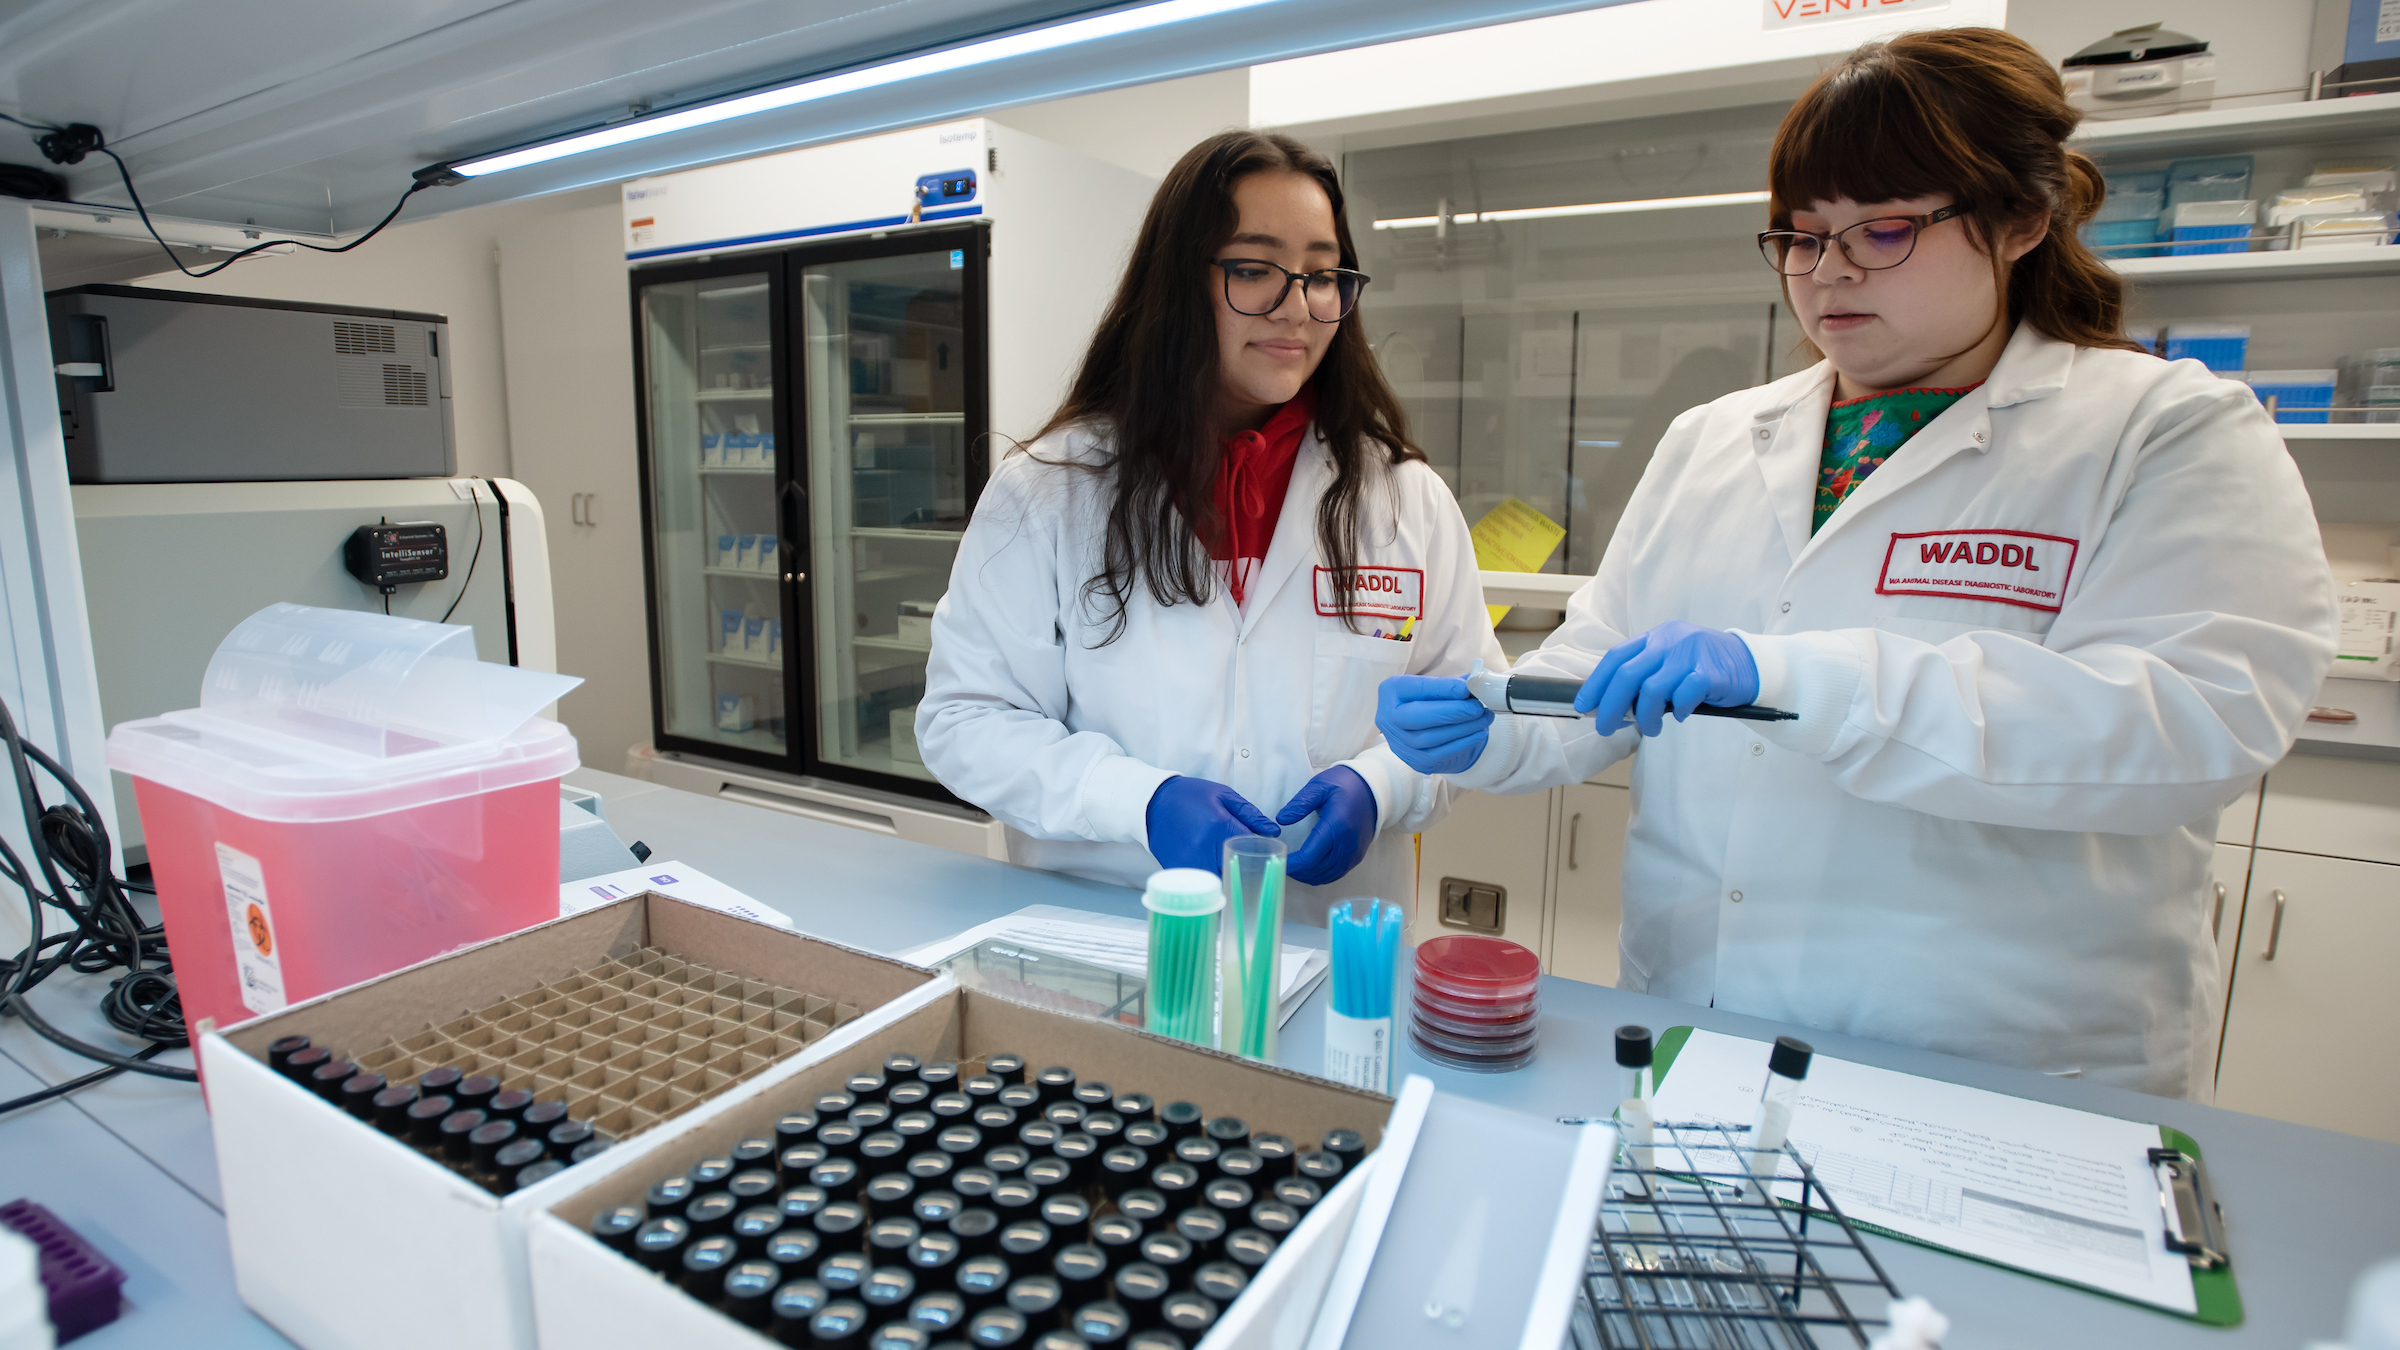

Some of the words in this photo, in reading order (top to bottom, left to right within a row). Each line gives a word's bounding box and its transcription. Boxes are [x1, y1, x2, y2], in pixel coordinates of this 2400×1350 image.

[381, 549, 434, 560] IntelliSensor
[1921, 541, 2039, 571] WADDL
[1965, 580, 2011, 591] DIAGNOSTIC
[2013, 585, 2056, 599] LABORATORY
